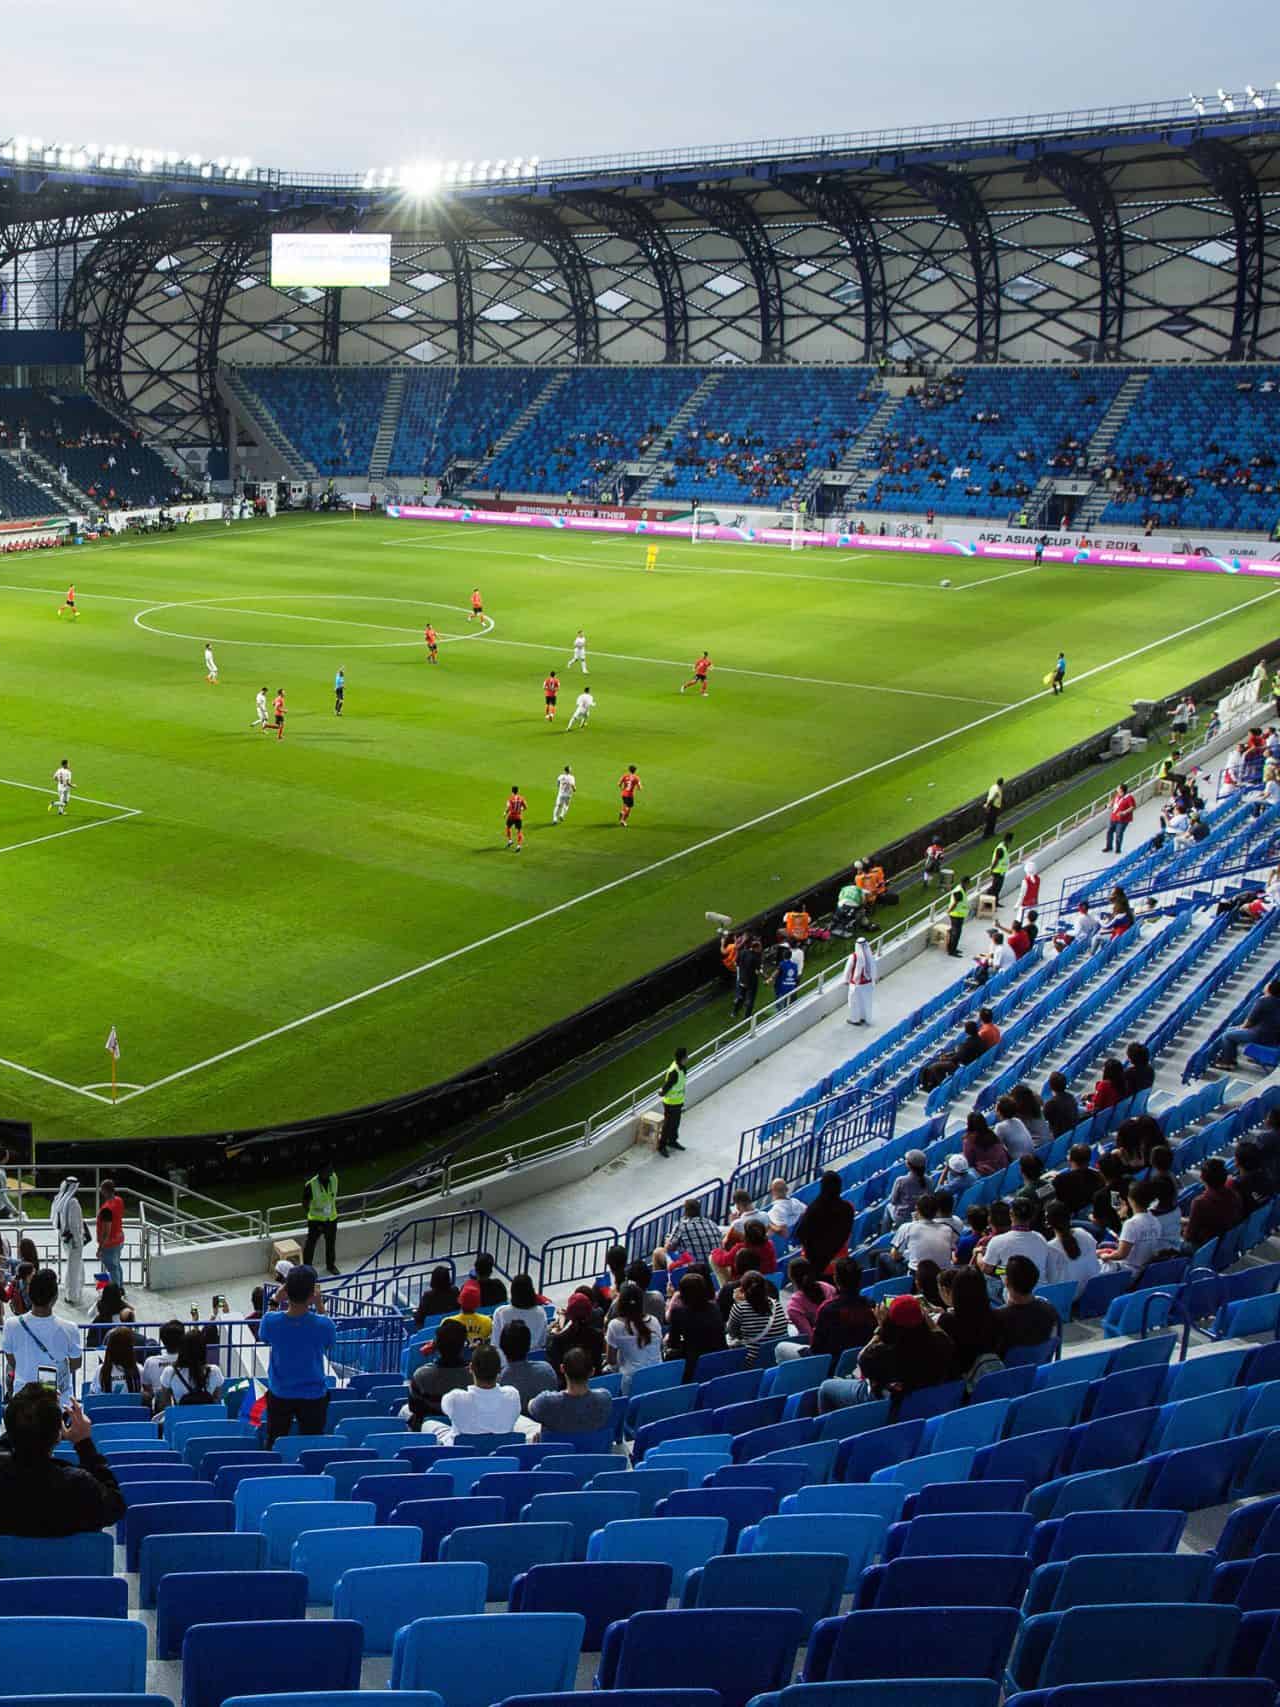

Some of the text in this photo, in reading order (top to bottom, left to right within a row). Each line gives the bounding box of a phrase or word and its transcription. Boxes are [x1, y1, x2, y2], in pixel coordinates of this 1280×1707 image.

[558, 508, 577, 517] ASIA
[979, 533, 1001, 543] AFC
[1047, 536, 1072, 547] CUP
[1075, 538, 1102, 549] AE
